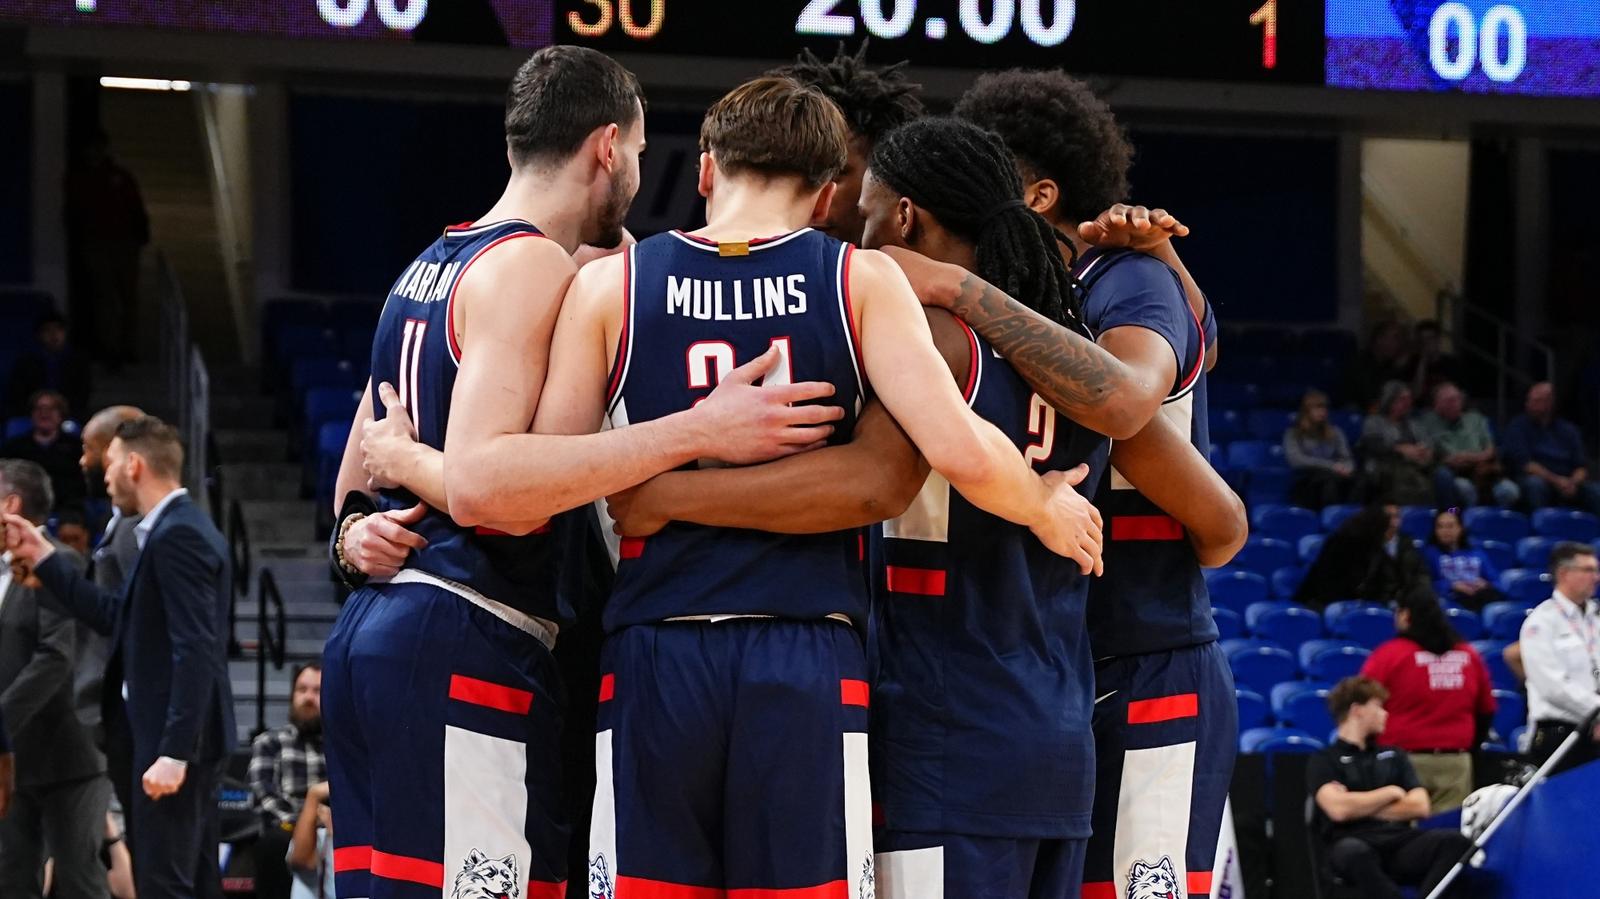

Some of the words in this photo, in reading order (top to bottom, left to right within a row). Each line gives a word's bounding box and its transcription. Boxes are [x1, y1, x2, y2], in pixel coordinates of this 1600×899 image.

[1249, 0, 1277, 69] 1
[1429, 2, 1527, 82] 00
[666, 273, 807, 321] MULLINS
[398, 318, 428, 442] 11
